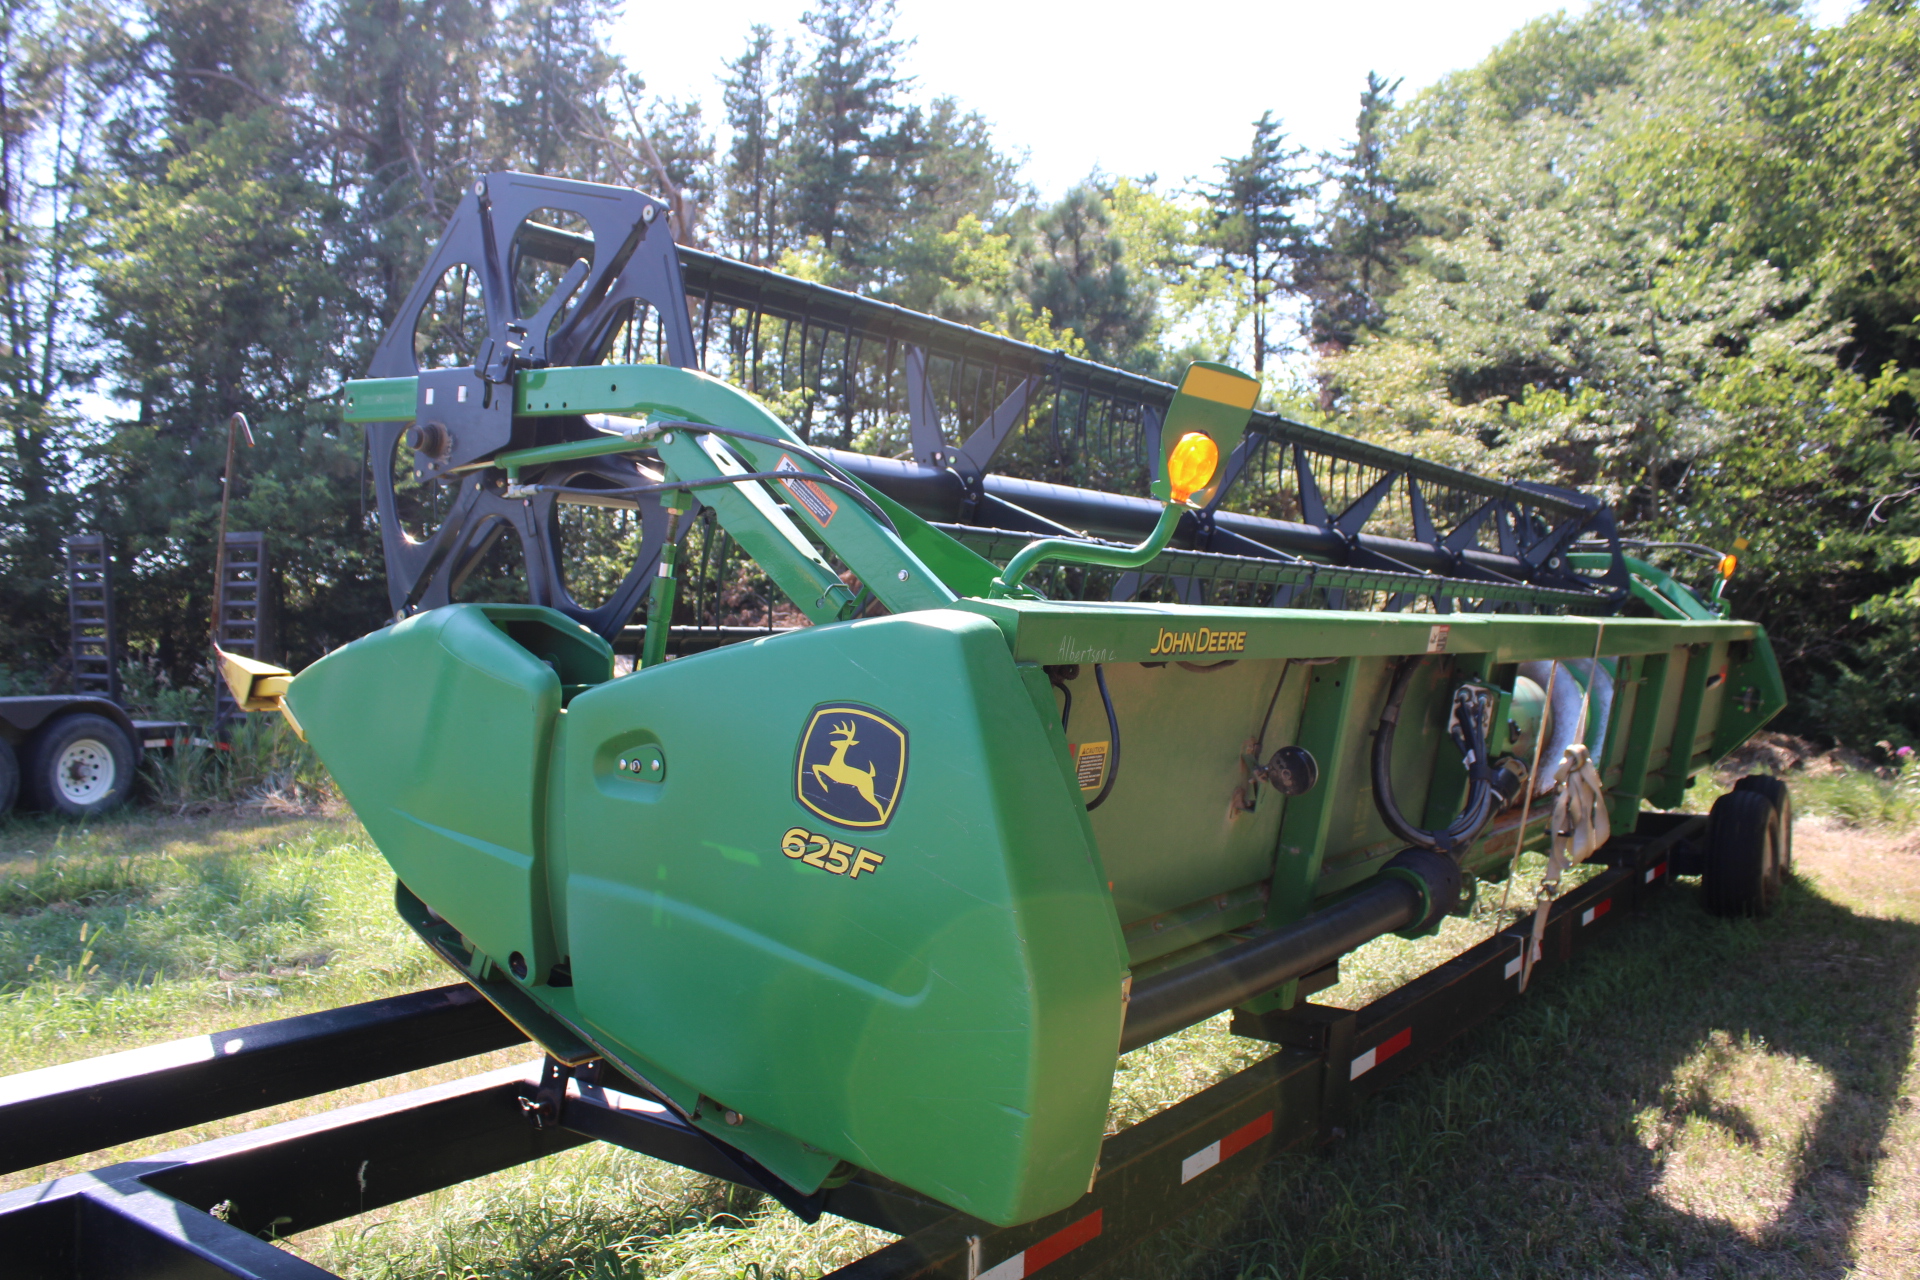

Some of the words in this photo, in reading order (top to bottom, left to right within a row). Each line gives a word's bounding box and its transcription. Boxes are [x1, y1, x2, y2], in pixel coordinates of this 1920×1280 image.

[810, 482, 831, 506] WARNING
[1150, 627, 1197, 655] JOHN
[1196, 627, 1247, 652] DEERE
[1085, 746, 1105, 754] CAUTION
[780, 826, 886, 881] 625F
